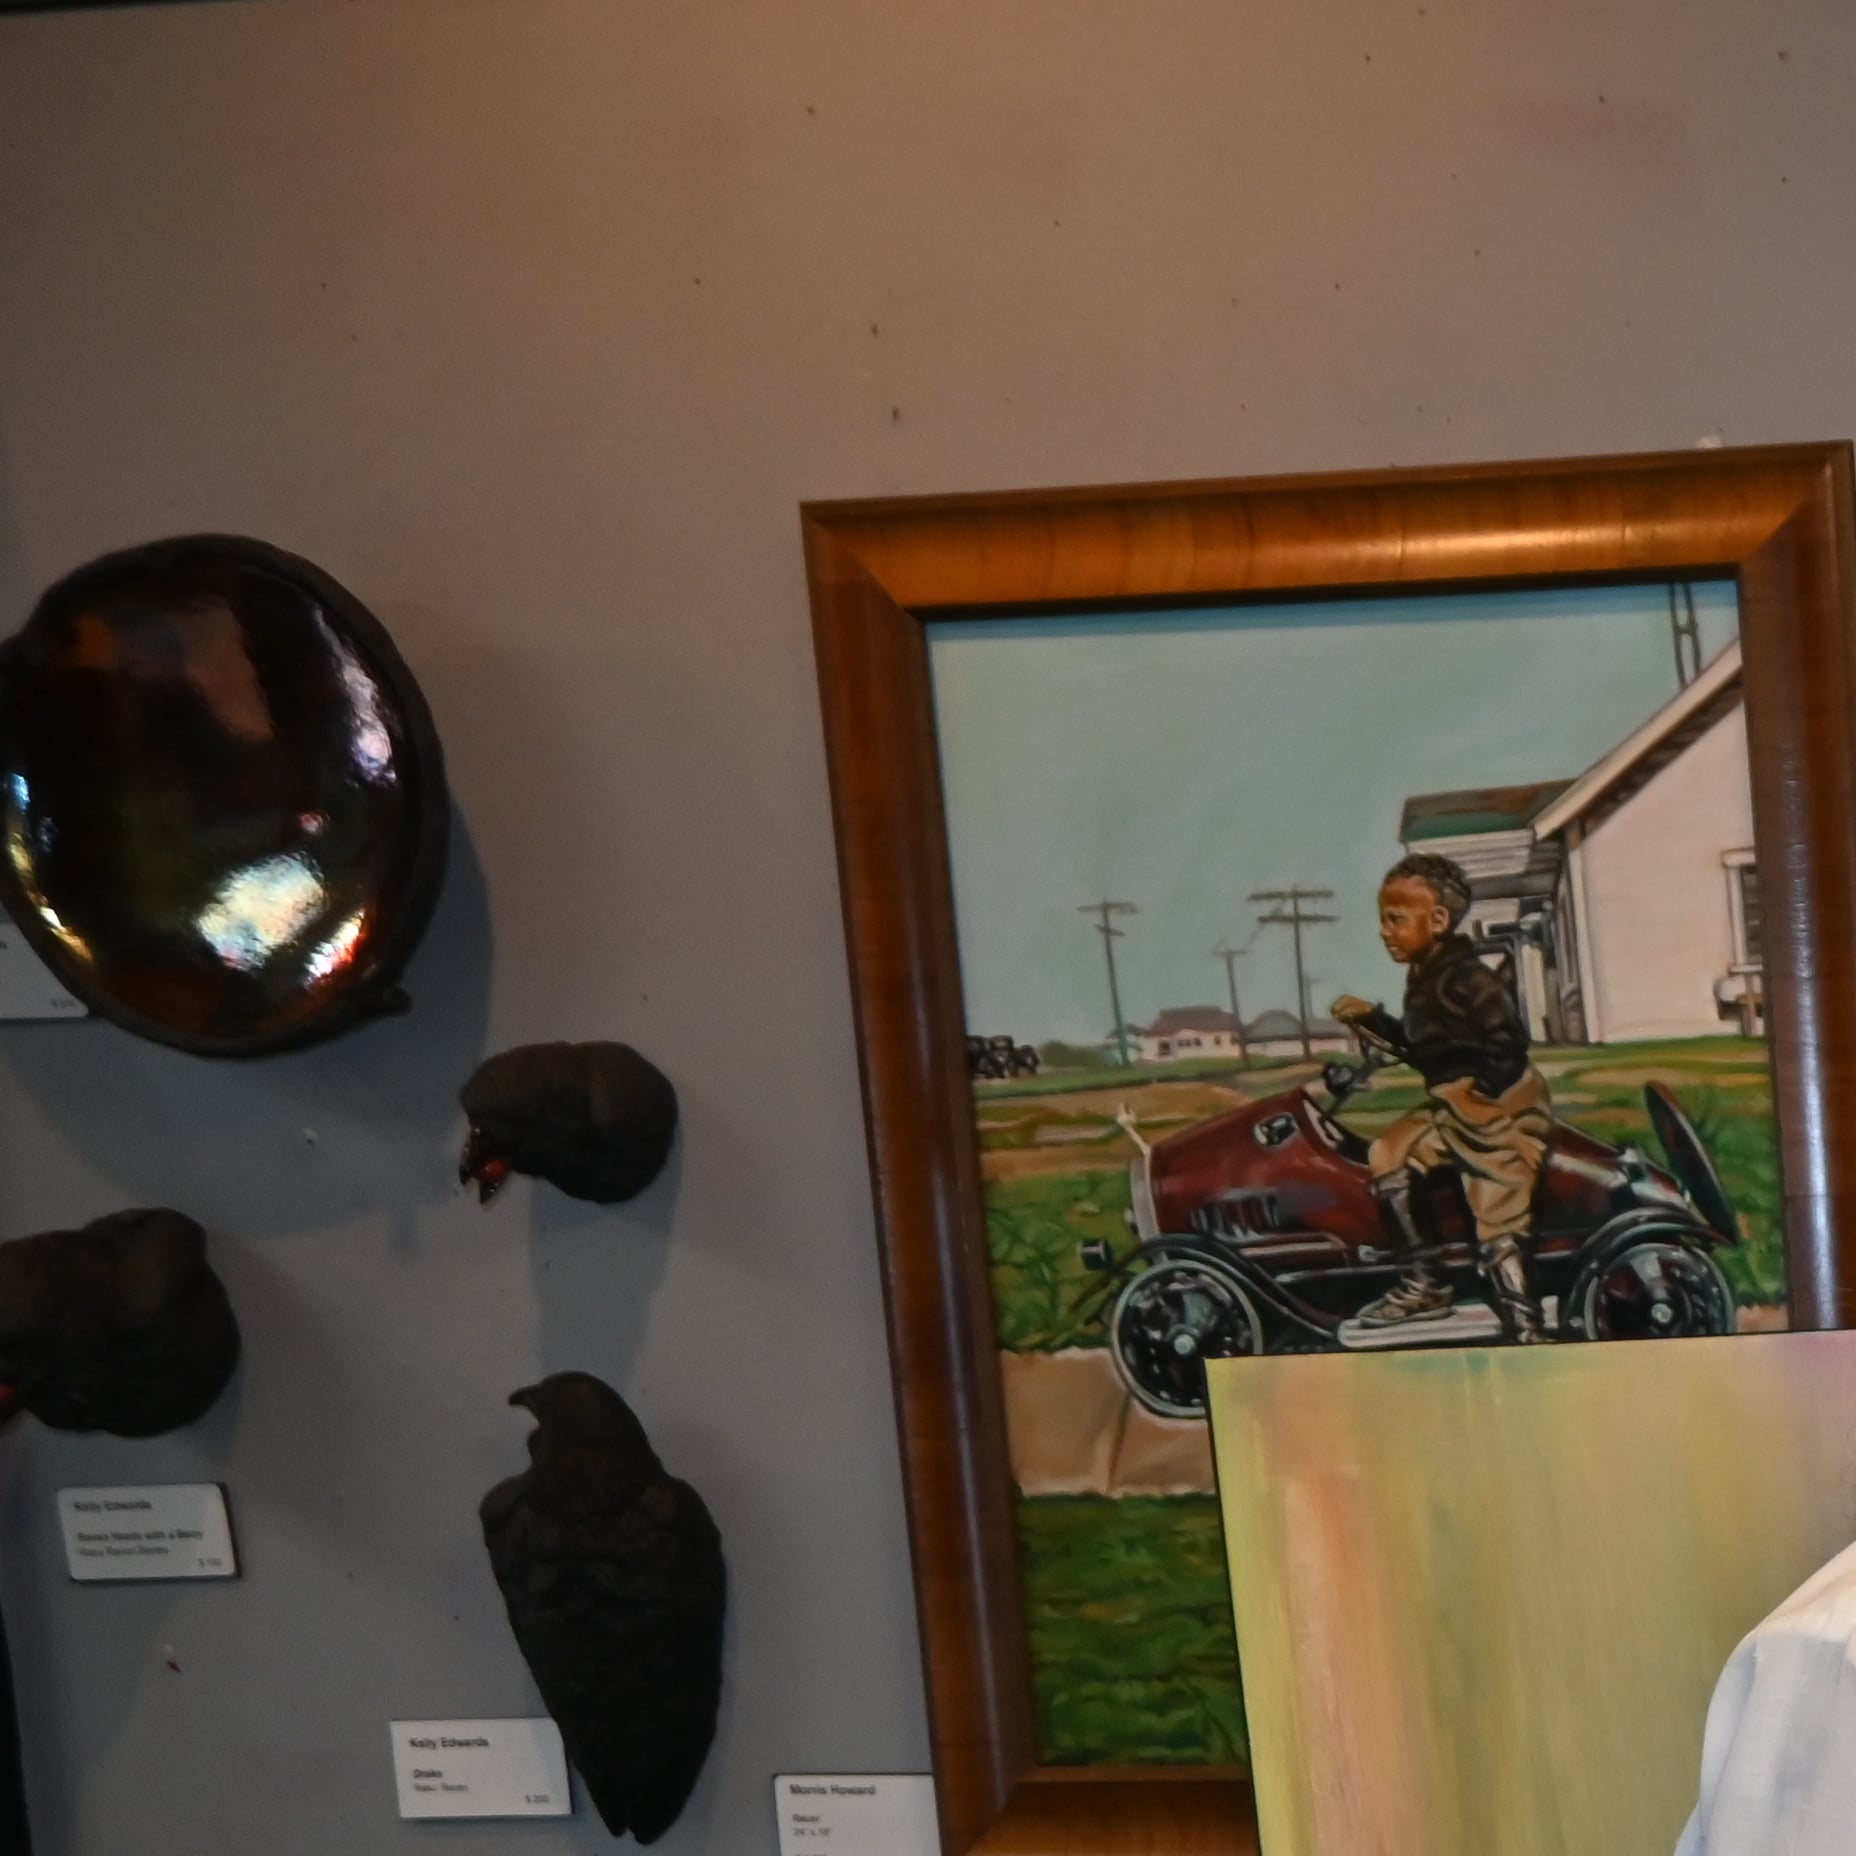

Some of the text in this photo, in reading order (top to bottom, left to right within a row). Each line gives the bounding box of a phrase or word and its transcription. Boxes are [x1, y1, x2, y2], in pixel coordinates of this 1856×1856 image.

[409, 1736, 489, 1749] Kelly Edwards
[789, 1784, 876, 1796] Morris Howard
